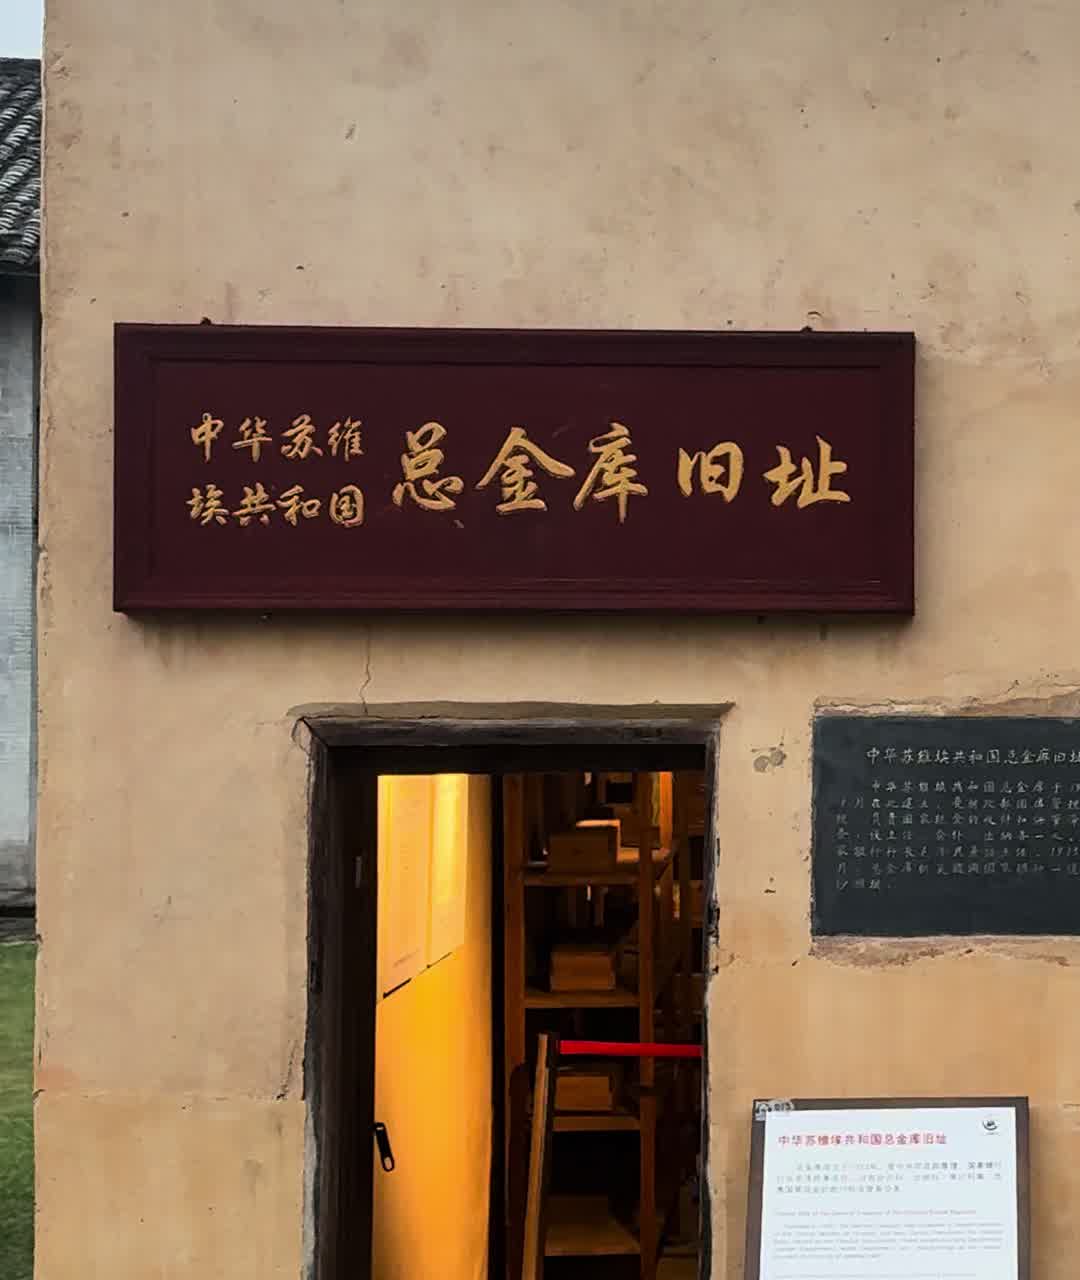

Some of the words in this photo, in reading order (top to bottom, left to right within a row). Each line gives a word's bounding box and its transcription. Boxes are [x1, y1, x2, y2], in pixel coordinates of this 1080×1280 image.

[190, 412, 364, 462] 中华苏维
[392, 421, 851, 524] 总金库旧址
[187, 483, 365, 528] 埃共和国
